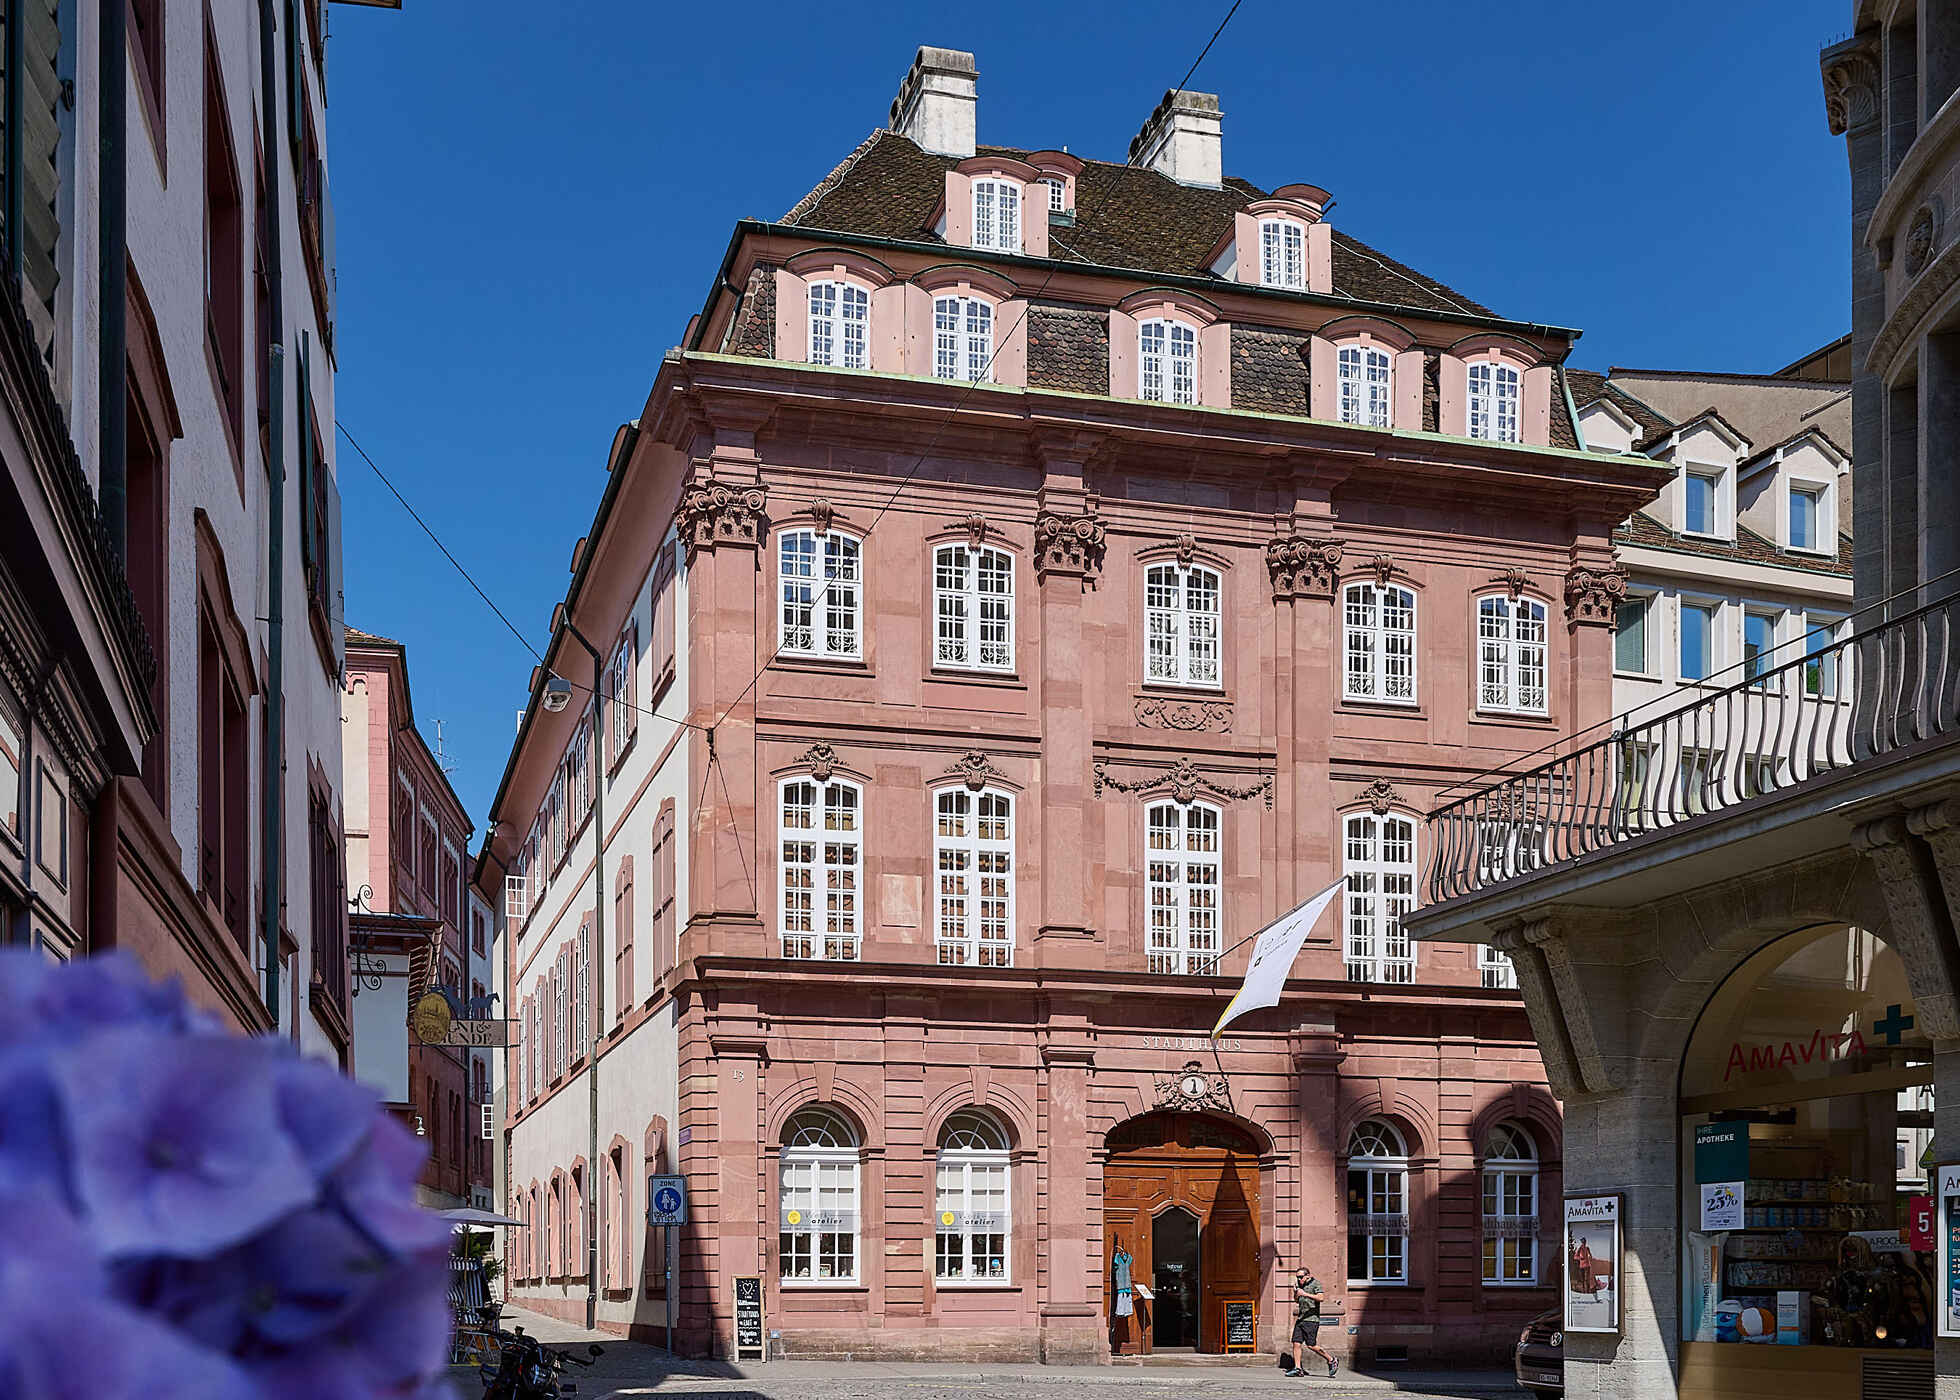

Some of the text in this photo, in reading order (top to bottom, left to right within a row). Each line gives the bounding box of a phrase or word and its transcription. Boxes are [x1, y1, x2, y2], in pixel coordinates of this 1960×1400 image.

[1142, 1036, 1241, 1050] STADTHUS
[1723, 1029, 1868, 1082] AMAVITA
[1696, 1133, 1736, 1145] APOTHEKE
[659, 1180, 677, 1188] ZONE
[1706, 1194, 1739, 1212] 25%
[1567, 1206, 1605, 1218] AMAVITA
